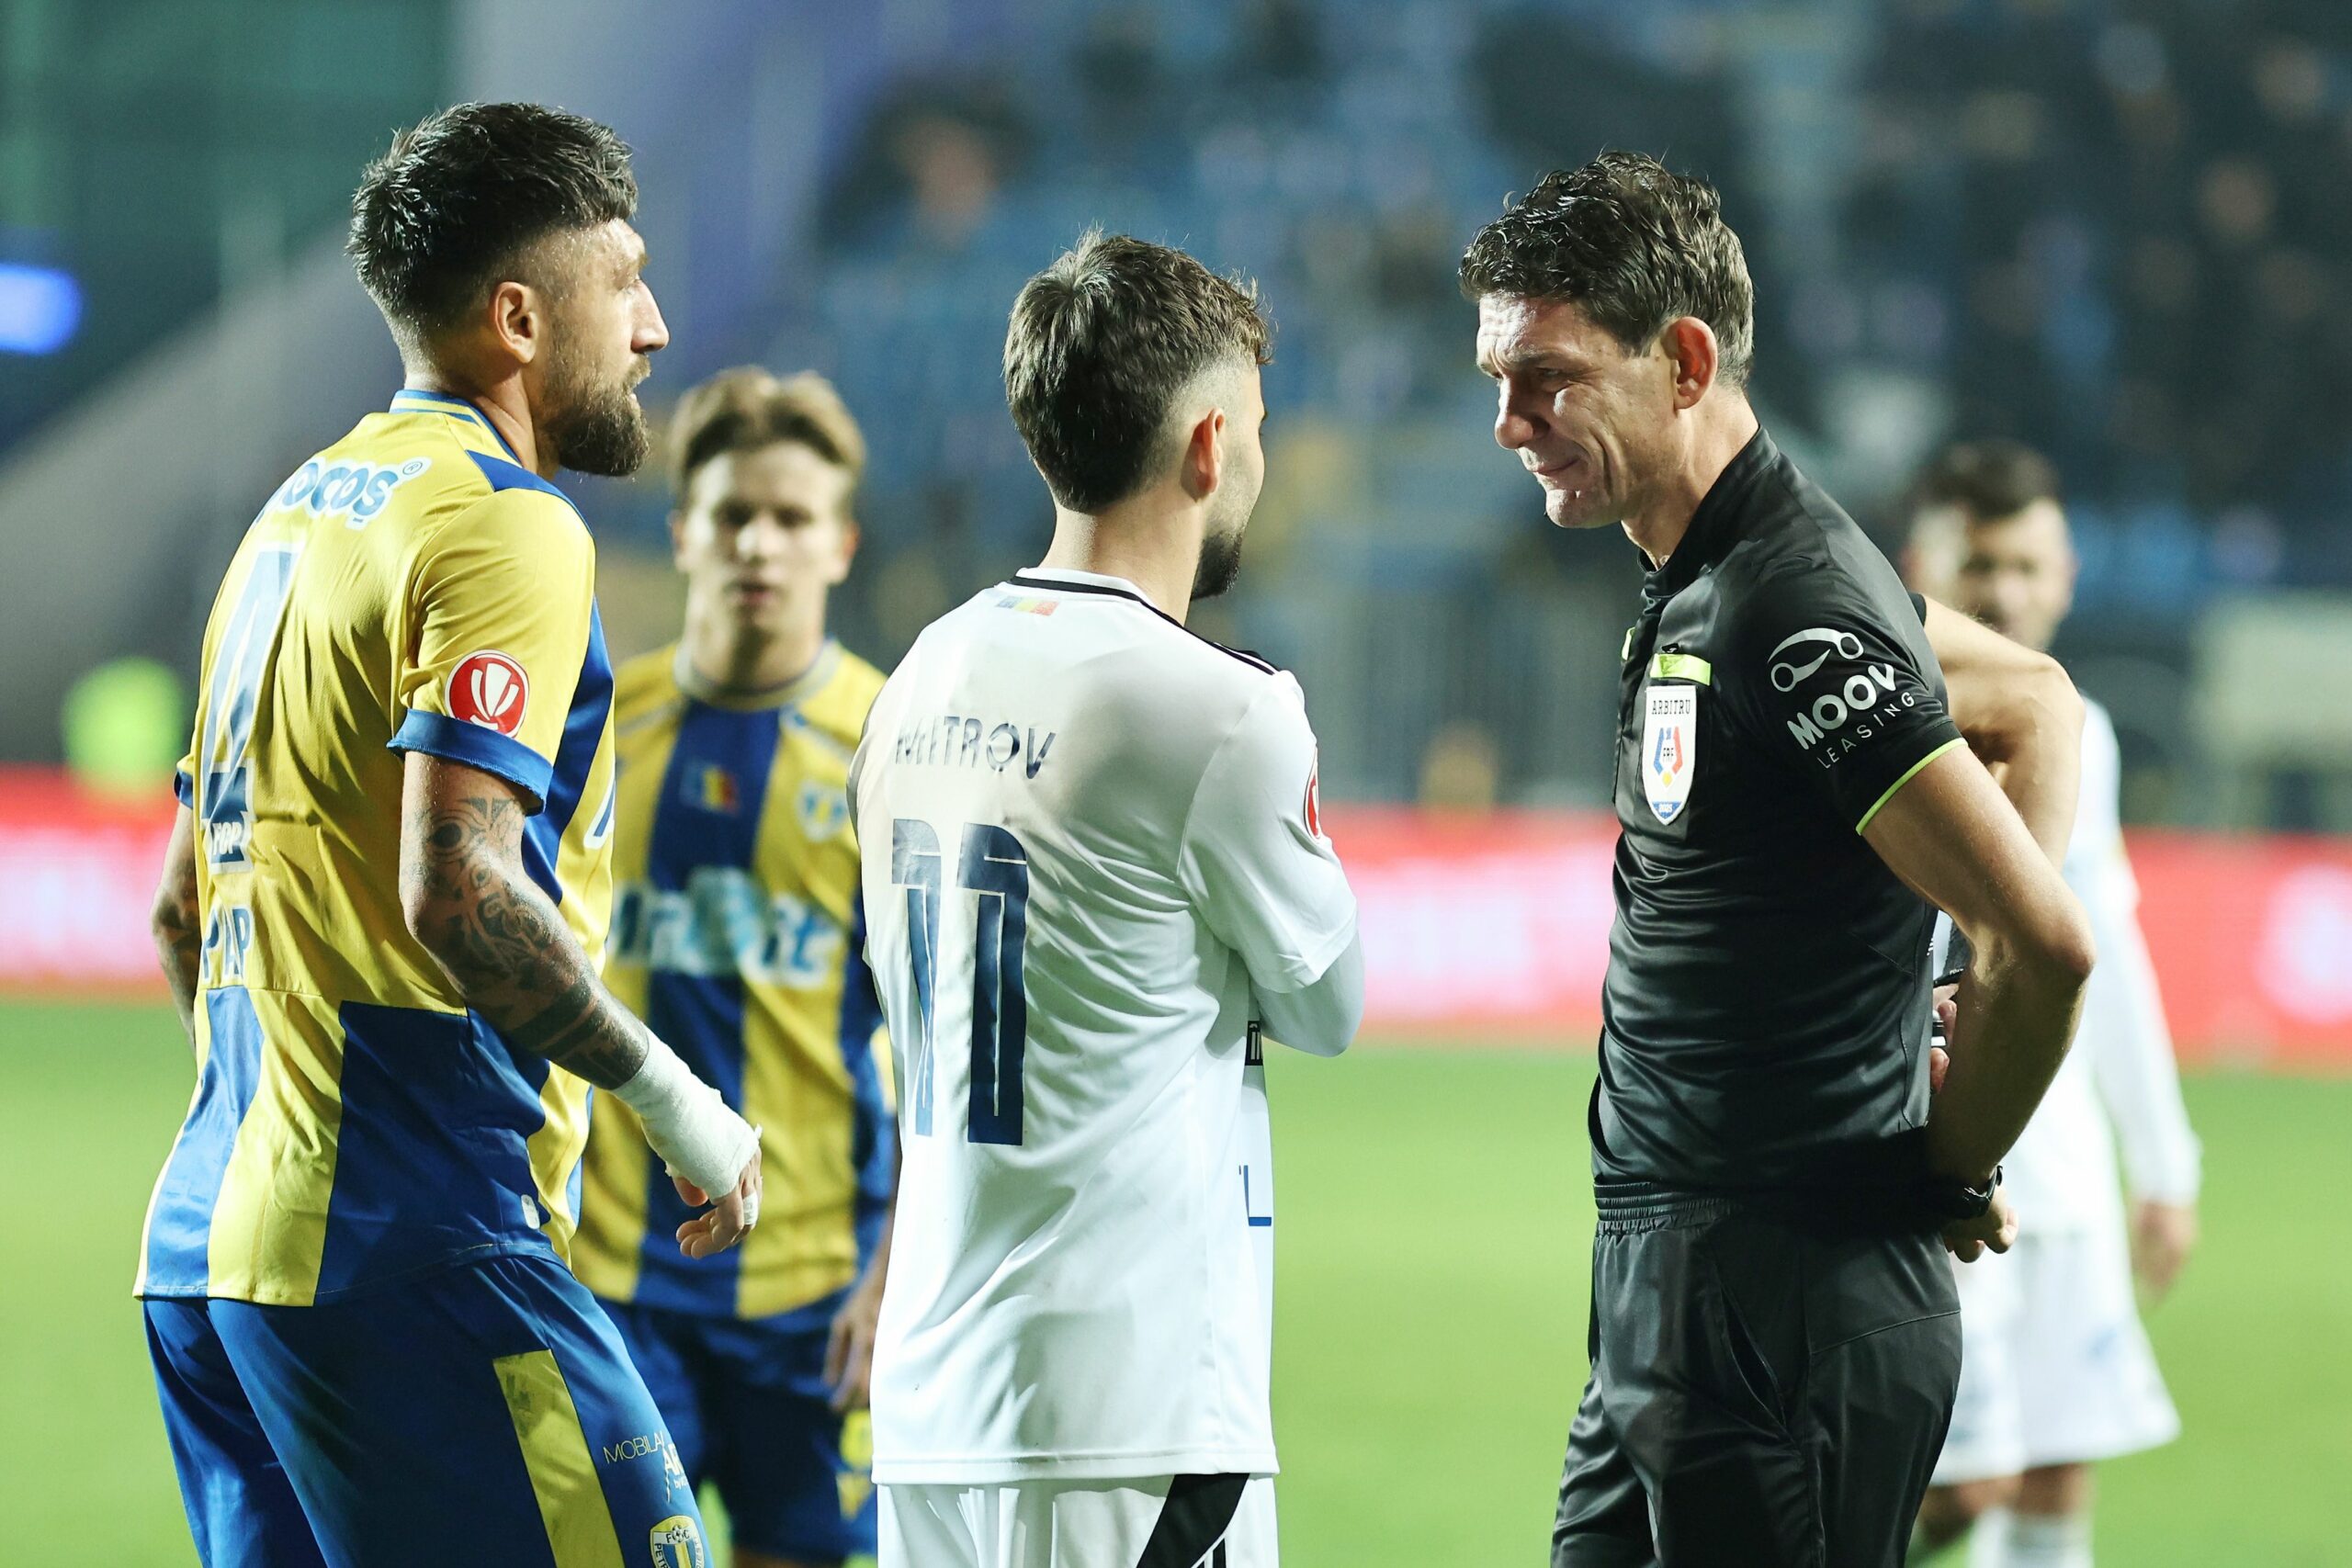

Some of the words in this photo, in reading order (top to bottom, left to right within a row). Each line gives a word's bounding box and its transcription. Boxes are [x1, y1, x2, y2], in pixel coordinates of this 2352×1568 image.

[1652, 699, 1691, 715] ARBITRU
[1787, 663, 1896, 750] MOOV
[1816, 692, 1915, 769] LEASING
[892, 818, 1028, 1145] 11
